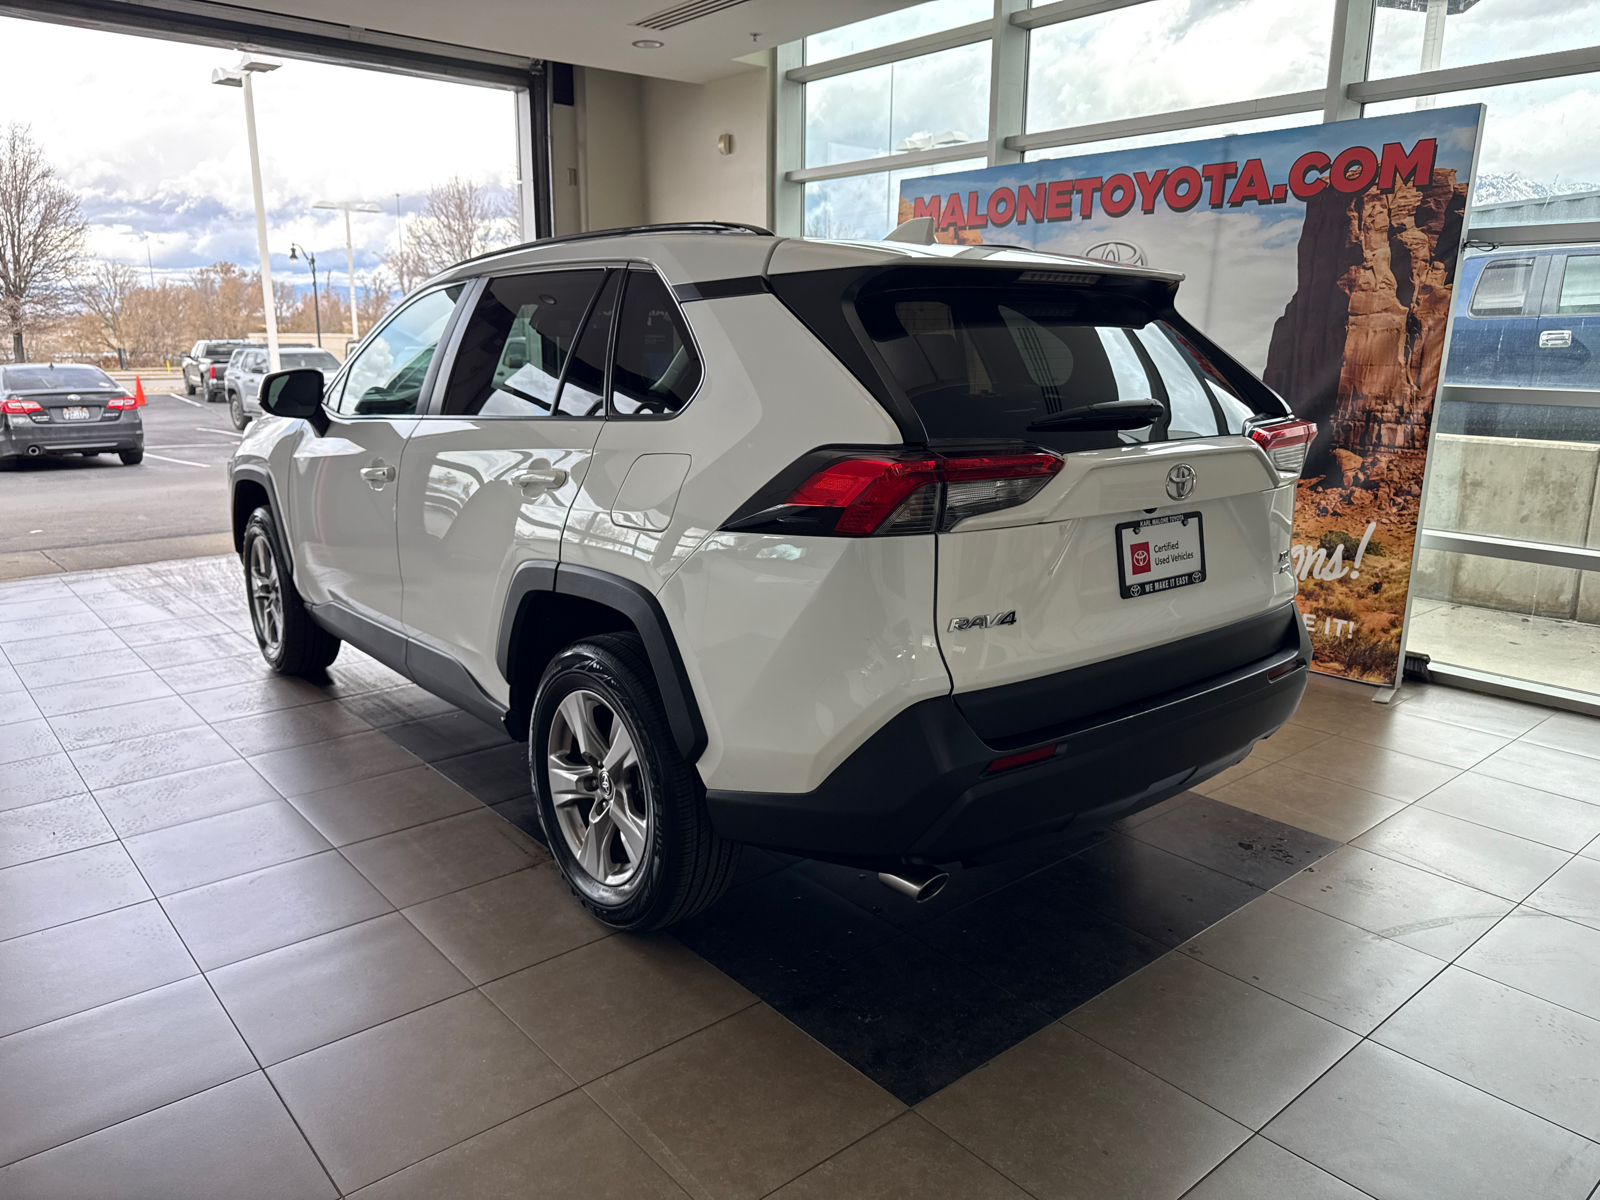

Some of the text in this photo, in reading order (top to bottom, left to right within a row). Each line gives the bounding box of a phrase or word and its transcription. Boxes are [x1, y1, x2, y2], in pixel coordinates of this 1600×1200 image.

[912, 137, 1438, 232] MALONETOYOTA.COM
[1154, 541, 1179, 553] Certified
[1154, 551, 1194, 566] Used Vehicles
[1144, 575, 1189, 593] WE MAKE IT EASY
[947, 609, 1017, 633] RAV4
[1324, 617, 1354, 639] IT!
